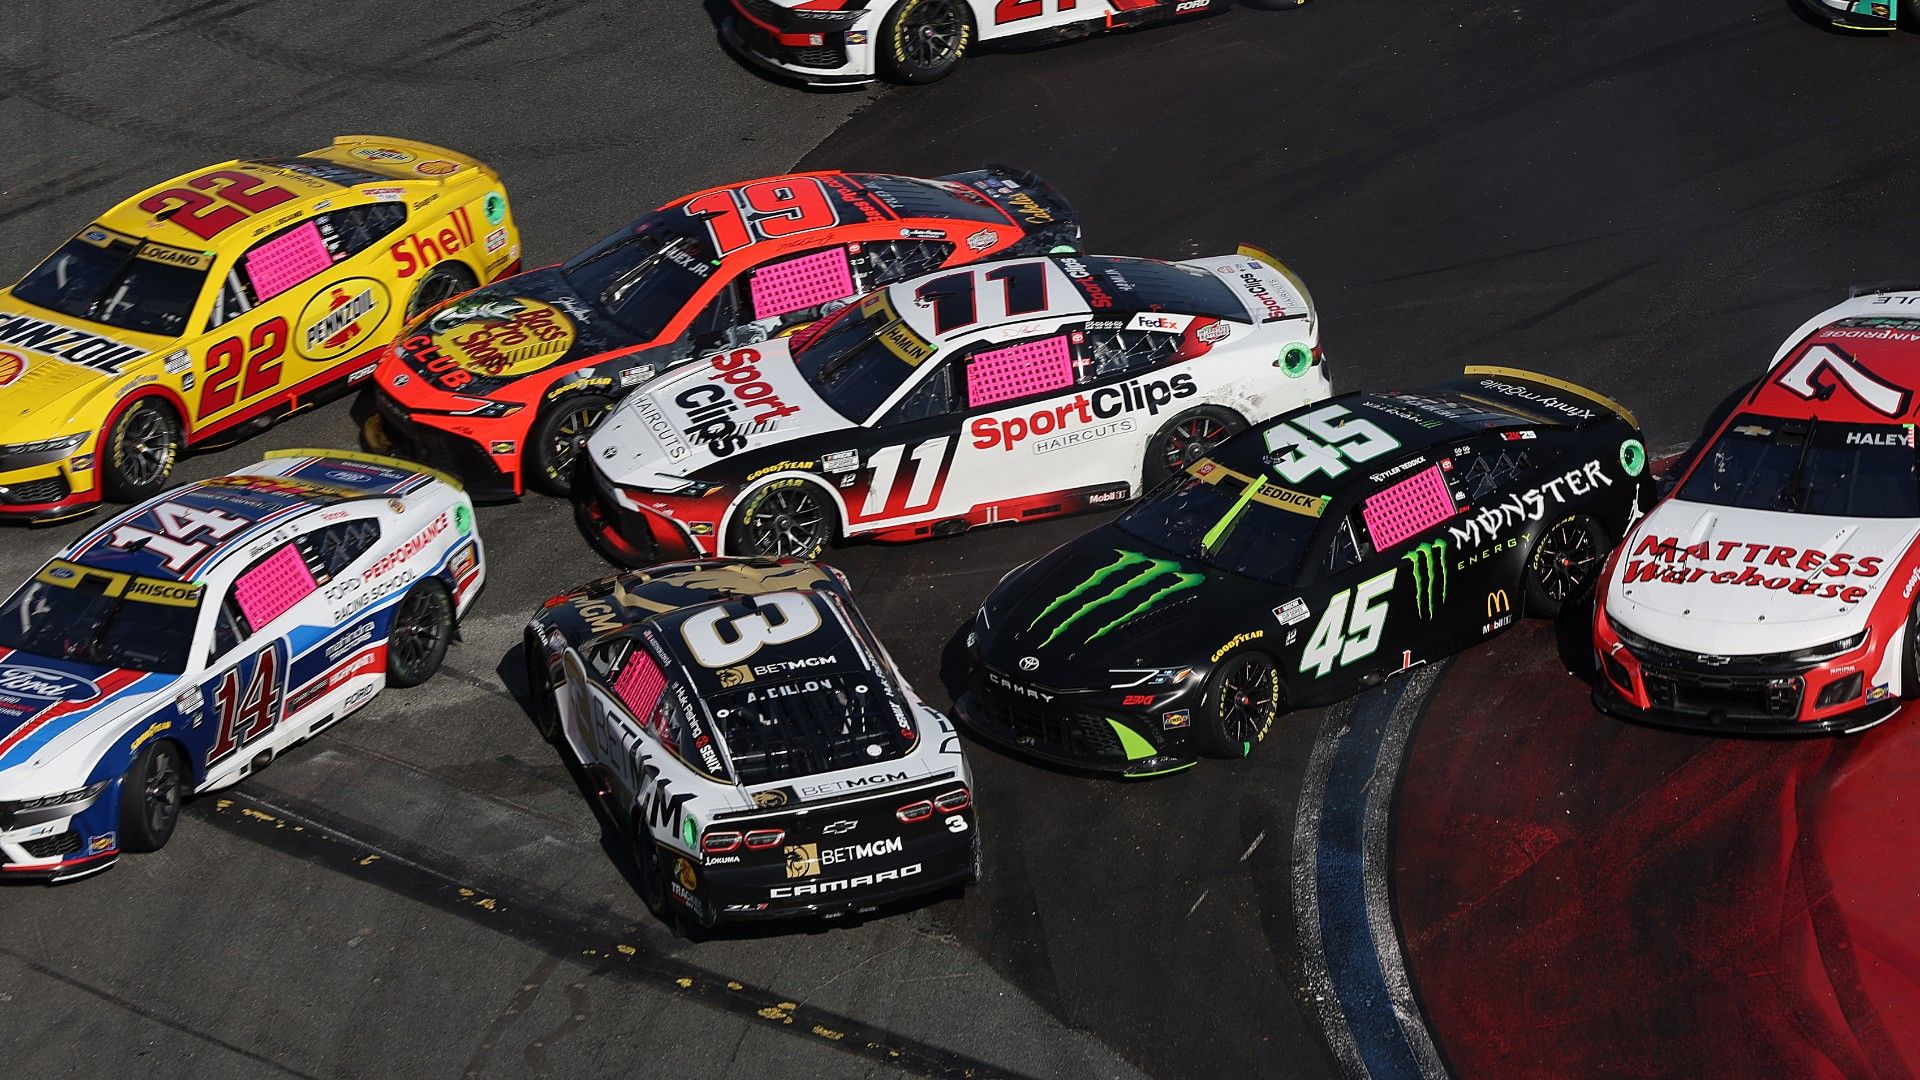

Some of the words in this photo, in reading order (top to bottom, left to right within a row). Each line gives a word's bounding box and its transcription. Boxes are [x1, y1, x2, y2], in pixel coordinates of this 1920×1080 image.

[138, 170, 300, 241] 22
[683, 176, 840, 258] 19
[142, 245, 199, 268] LOGANO
[390, 206, 475, 277] Shell
[915, 261, 1048, 336] 11
[306, 288, 376, 353] PENNZOIL
[484, 320, 533, 347] Pro
[512, 309, 568, 342] Bass
[1138, 316, 1178, 330] FedEx
[0, 313, 148, 375] NNZOIL
[453, 331, 513, 376] Shops
[886, 324, 926, 360] HAMLIN
[197, 316, 288, 421] 22
[348, 363, 377, 383] FORD
[402, 334, 474, 390] CLUB
[548, 377, 612, 400] GOODYEAR
[709, 348, 800, 425] Sport
[1480, 378, 1539, 402] mobile
[1773, 343, 1914, 419] 7
[675, 384, 748, 458] Clips
[1537, 396, 1597, 420] xfinity
[635, 395, 685, 459] HAIRCUTS
[1036, 420, 1132, 452] HAIRCUTS
[1263, 404, 1401, 484] 45
[1846, 431, 1909, 446] HALEY
[746, 460, 814, 481] GOODYEAR
[861, 436, 950, 517] 11
[1380, 466, 1401, 480] TYLER
[1400, 456, 1426, 470] REDDICK
[1090, 491, 1115, 504] Mobil
[1257, 485, 1316, 508] REDDICK
[1449, 459, 1612, 550] MONSTER
[108, 501, 253, 573] 14
[1457, 533, 1531, 570] ENERGY
[324, 578, 363, 602] FORD
[361, 512, 449, 584] PERFORMANCE
[1633, 534, 1884, 578] MATTRESS
[333, 593, 371, 625] RACING
[370, 571, 418, 599] SCHOOL
[1622, 559, 1869, 603] Warehouse
[680, 590, 823, 669] 3
[1299, 567, 1398, 680] 45
[1211, 630, 1264, 662] GOODYEAR
[0, 667, 78, 697] Ford
[754, 655, 837, 676] BETMGM
[206, 643, 281, 769] 14
[344, 684, 374, 709] FORD
[747, 691, 766, 703] A.
[768, 679, 832, 698] DILLON
[989, 674, 1054, 703] CAMRY
[1257, 669, 1279, 742] GOODYEAR
[675, 685, 688, 707] Huk
[683, 704, 702, 739] Fishing
[700, 744, 723, 774] SENIX
[801, 771, 908, 796] BETMGM
[945, 814, 968, 833] 3
[821, 836, 903, 866] BETMGM
[770, 863, 922, 898] CAMARO
